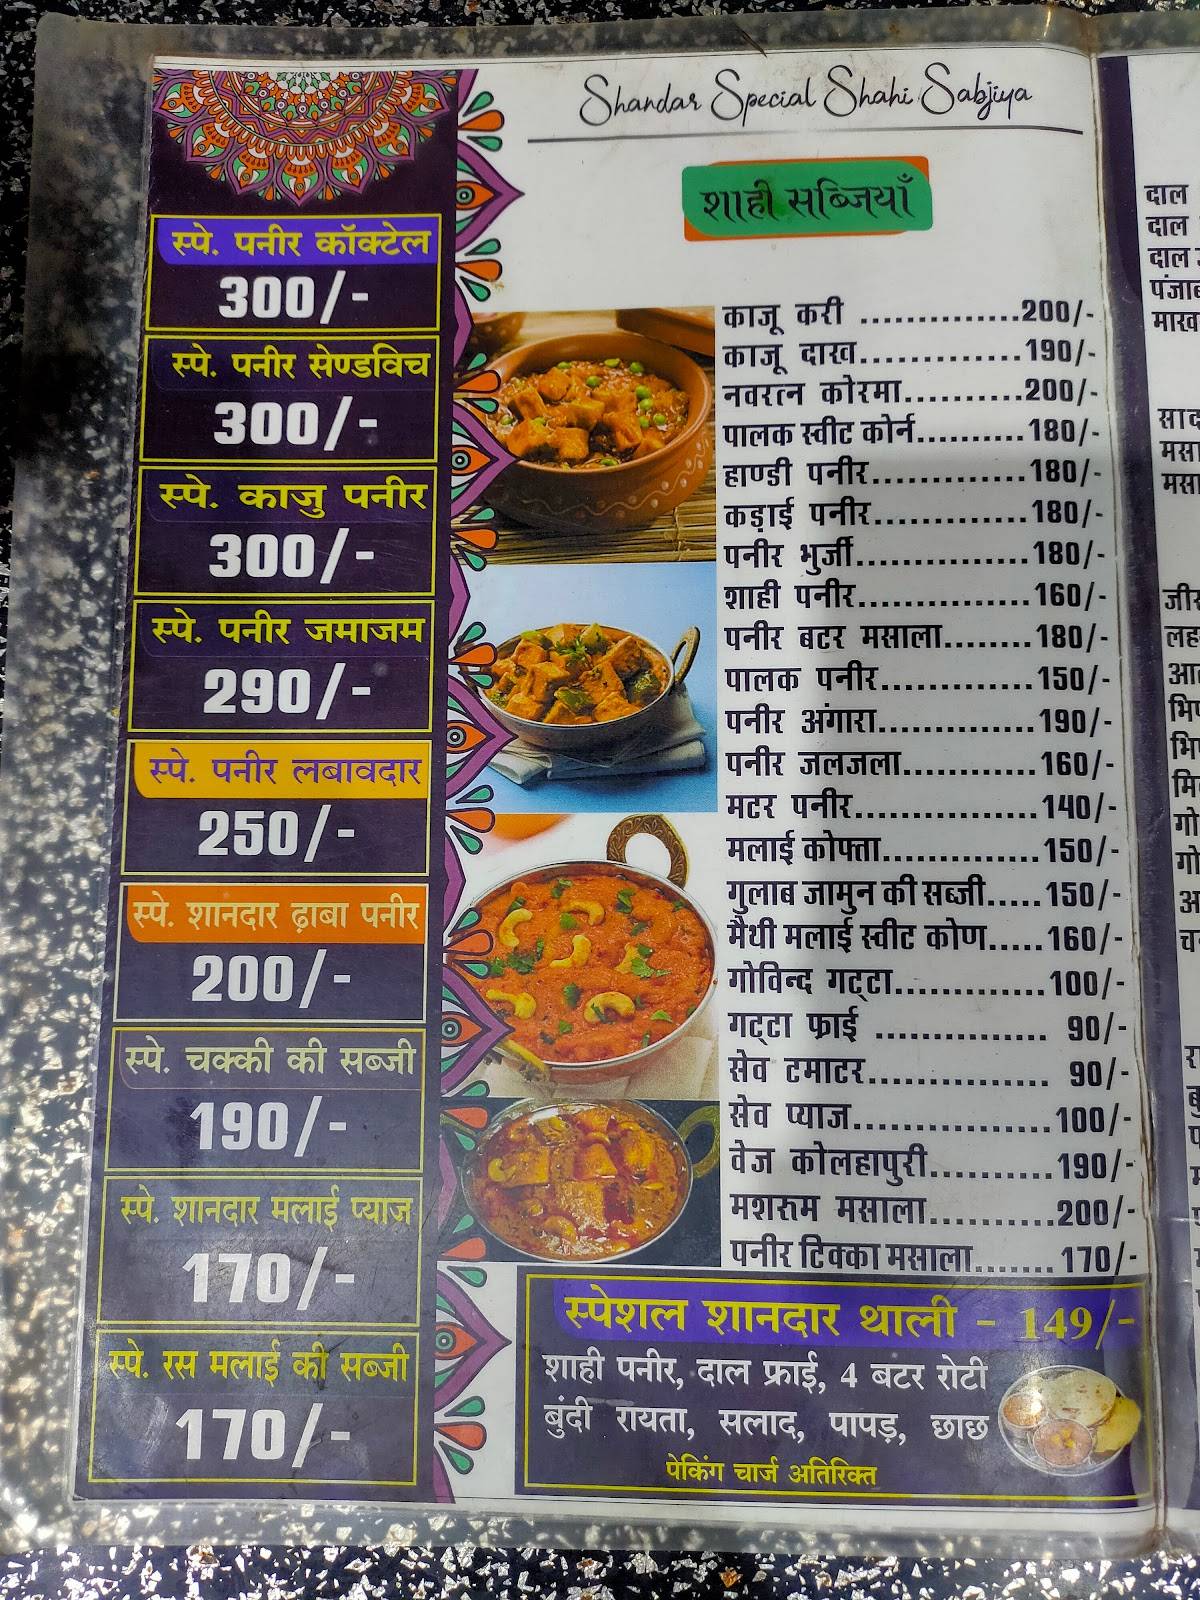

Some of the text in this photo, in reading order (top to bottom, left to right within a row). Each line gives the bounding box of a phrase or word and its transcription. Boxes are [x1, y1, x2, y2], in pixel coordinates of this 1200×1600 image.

[579, 62, 1033, 127] Shandar Special Shahi Sabjiya
[700, 173, 913, 222] शाही सब्जियाँ
[1144, 184, 1189, 205] दाल
[172, 222, 431, 256] स्पे. पनीर कॉक्टेल
[1146, 216, 1189, 237] दाल
[1147, 247, 1191, 268] दाल
[219, 270, 369, 324] 300/-
[722, 296, 1094, 335] काजू करी 200/-
[172, 344, 430, 379] स्पे. पनीर सेण्डविच
[722, 339, 1096, 374] काजू दाख 190/-
[722, 375, 1098, 407] नवरत्न कोरमा 200/-
[214, 396, 377, 451] 300/-
[722, 414, 1100, 447] पालक स्वीट कोर्न 180/-
[723, 455, 1101, 487] हाण्डी पनीर 180/-
[159, 473, 428, 519] स्पे. काजु पनीर
[724, 496, 1103, 532] कड़ाई पनीर 180/-
[209, 528, 374, 584] 300/-
[724, 536, 1105, 575] पनीर भुर्जी 180/-
[724, 578, 1107, 611] शाही पनीर 160/-
[152, 608, 426, 644] स्पे. पनीर जमाजम
[724, 620, 1108, 652] पनीर बटर मसाला 180/-
[203, 662, 371, 720] 290/-
[725, 660, 1110, 695] पालक पनीर 150/-
[725, 703, 1112, 737] पनीर अंगारा 190/-
[149, 748, 422, 786] स्पे. पनीर लबावदार
[725, 745, 1114, 780] पनीर जलजला 160/-
[726, 787, 1117, 823] मटर पनीर 140/-
[198, 804, 355, 862] 250/-
[726, 830, 1119, 866] मलाई कोफ्ता 150/-
[132, 891, 420, 934] स्पे. शानदार ढ़ाबा पनीर
[727, 874, 1121, 914] गुलाब जामुन की सब्जी 150/-
[783, 918, 853, 953] मलाई
[860, 918, 916, 950] स्वीट
[924, 918, 987, 950] कोण
[1048, 923, 1123, 955] 160/-
[191, 949, 352, 1009] 200/-
[727, 960, 1125, 1002] गोविन्द गट्टा 100/-
[728, 1006, 1127, 1046] गट्टा फ्राई 90/-
[125, 1035, 416, 1075] स्पे. चक्की की सब्जी
[728, 1049, 1129, 1090] सेव टमाटर 90/-
[189, 1095, 347, 1157] 190/-
[728, 1094, 1131, 1136] सेव प्याज 100/-
[729, 1139, 1134, 1186] वेज कोलहापुरी 190/-
[120, 1185, 413, 1227] स्पे. शानदार मलाई प्याज
[835, 1197, 927, 1226] मसाला
[1057, 1195, 1136, 1229] 200/-
[729, 1233, 1137, 1275] पनीर टिक्का मसाला 170/-
[182, 1246, 354, 1311] 170/-
[565, 1285, 688, 1331] स्पेशल
[706, 1303, 841, 1337] शानदार
[860, 1294, 958, 1338] थाली
[1018, 1299, 1135, 1351] 149/-
[109, 1338, 409, 1387] स्पे. रस मलाई की सब्जी
[542, 1348, 988, 1393] शाही पनीर, दाल फ्राई, 4 बटर रोटी
[175, 1402, 350, 1468] 170/-
[543, 1397, 990, 1446] बुंदी रायता, सलाद, पापड़, छाछ
[733, 1455, 778, 1484] चार्ज
[788, 1457, 878, 1487] अतिरिक्त
